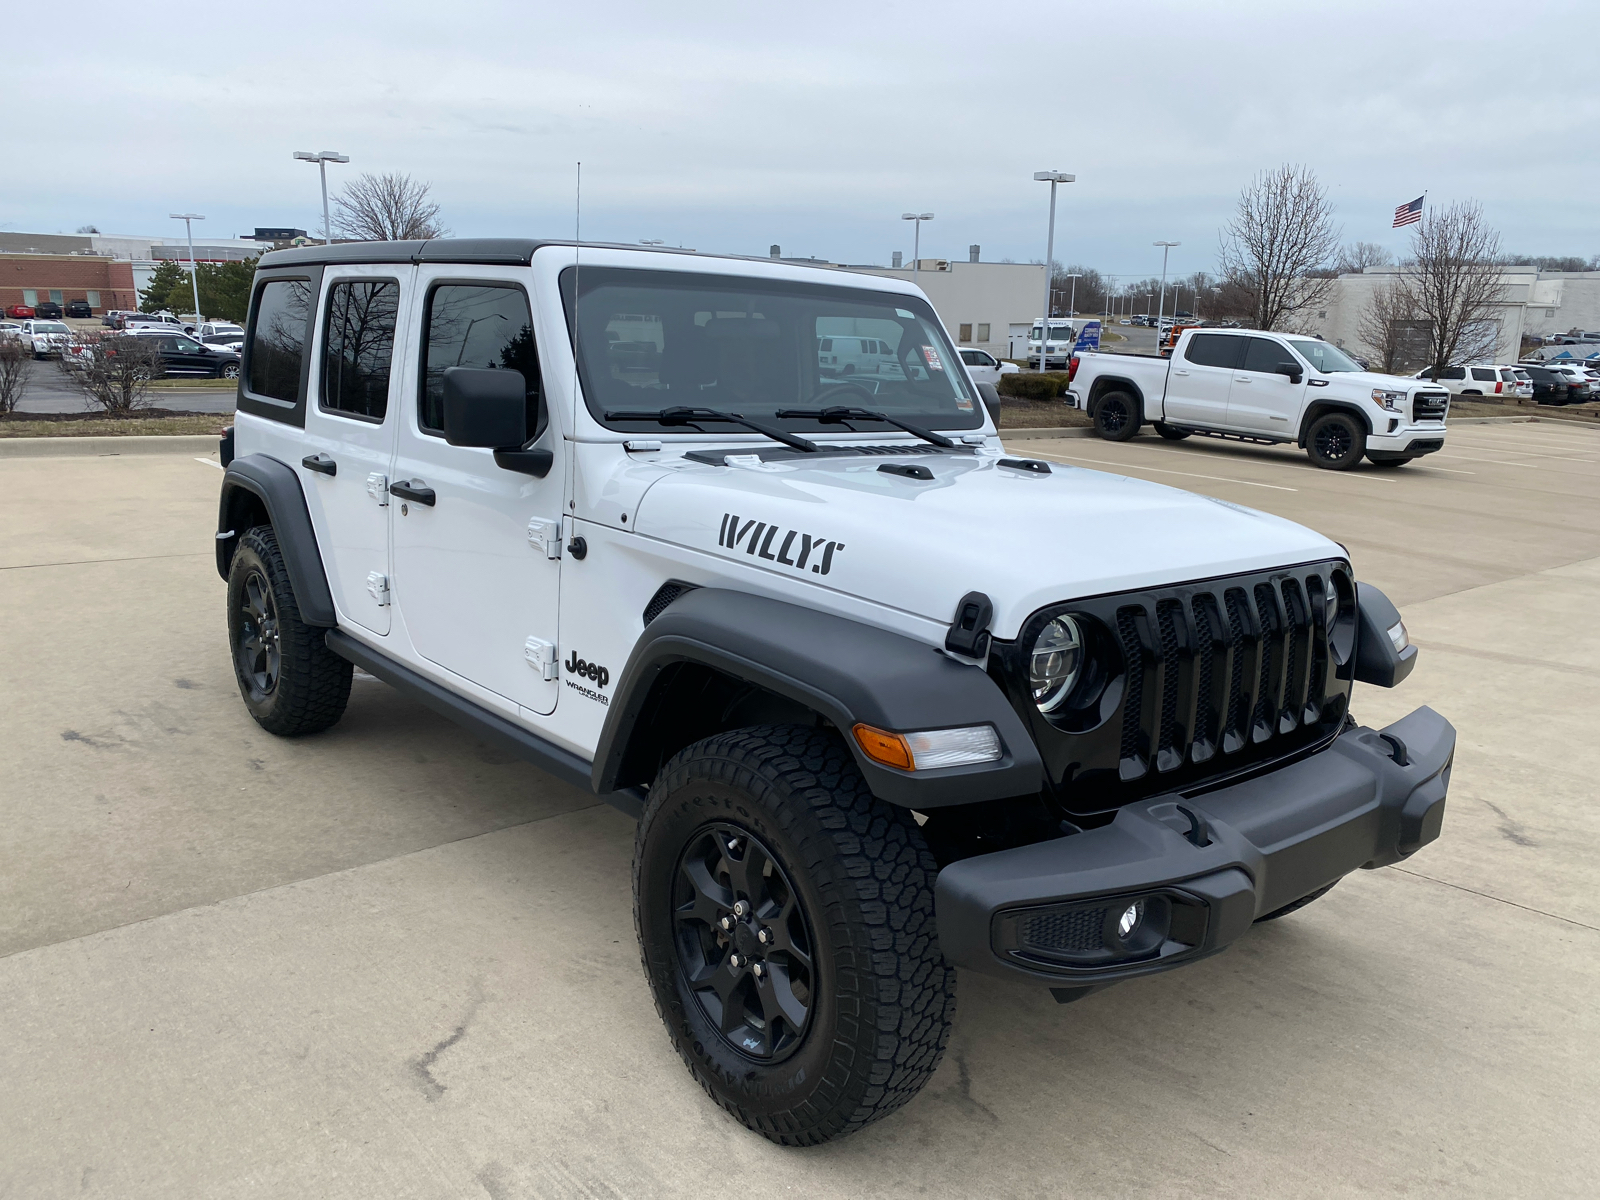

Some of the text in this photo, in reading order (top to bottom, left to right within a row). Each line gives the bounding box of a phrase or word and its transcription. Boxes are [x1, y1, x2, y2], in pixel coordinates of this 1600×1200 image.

[718, 513, 846, 575] WILLYS
[565, 650, 609, 689] Jeep
[565, 679, 609, 702] WRANGLER
[578, 691, 609, 706] UNLIMITED
[665, 795, 783, 849] irestone
